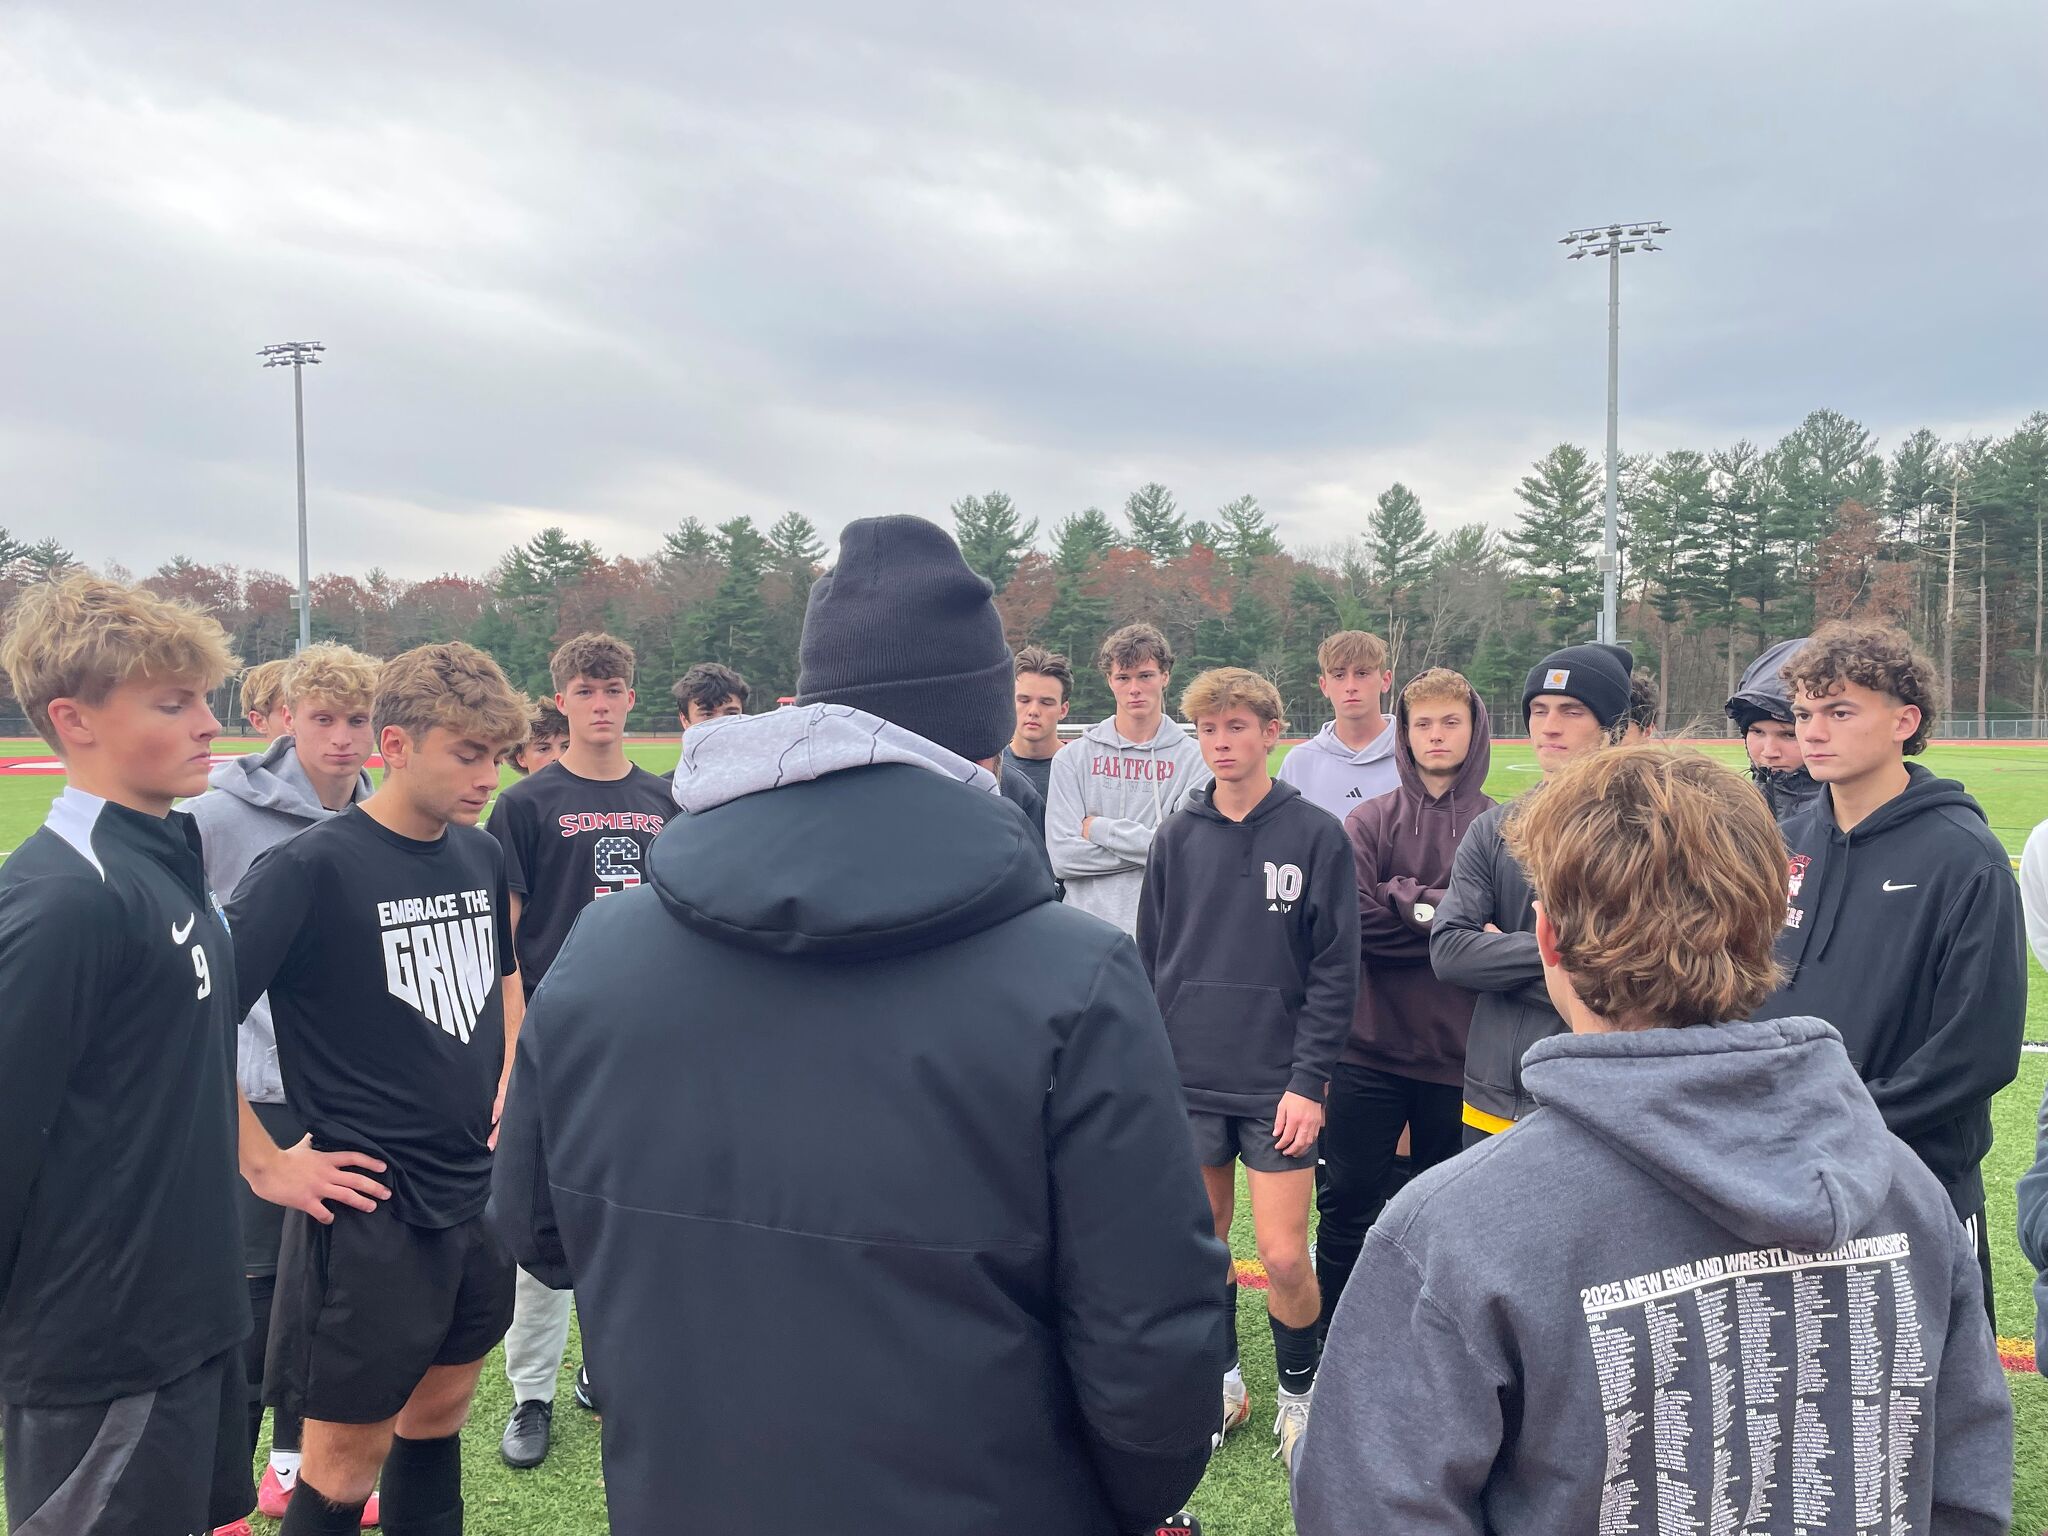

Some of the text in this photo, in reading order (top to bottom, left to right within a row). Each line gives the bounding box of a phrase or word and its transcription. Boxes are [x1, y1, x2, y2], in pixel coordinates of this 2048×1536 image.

[1092, 756, 1175, 780] HARTFORD
[559, 812, 664, 837] SOMERS
[1264, 861, 1303, 901] 10
[377, 890, 490, 926] EMBRACE THE
[191, 944, 211, 1000] 9
[381, 915, 495, 1044] GRIND
[1580, 1281, 1624, 1308] 2025
[1624, 1273, 1662, 1299] NEW
[1662, 1256, 1723, 1289] ENGLAND
